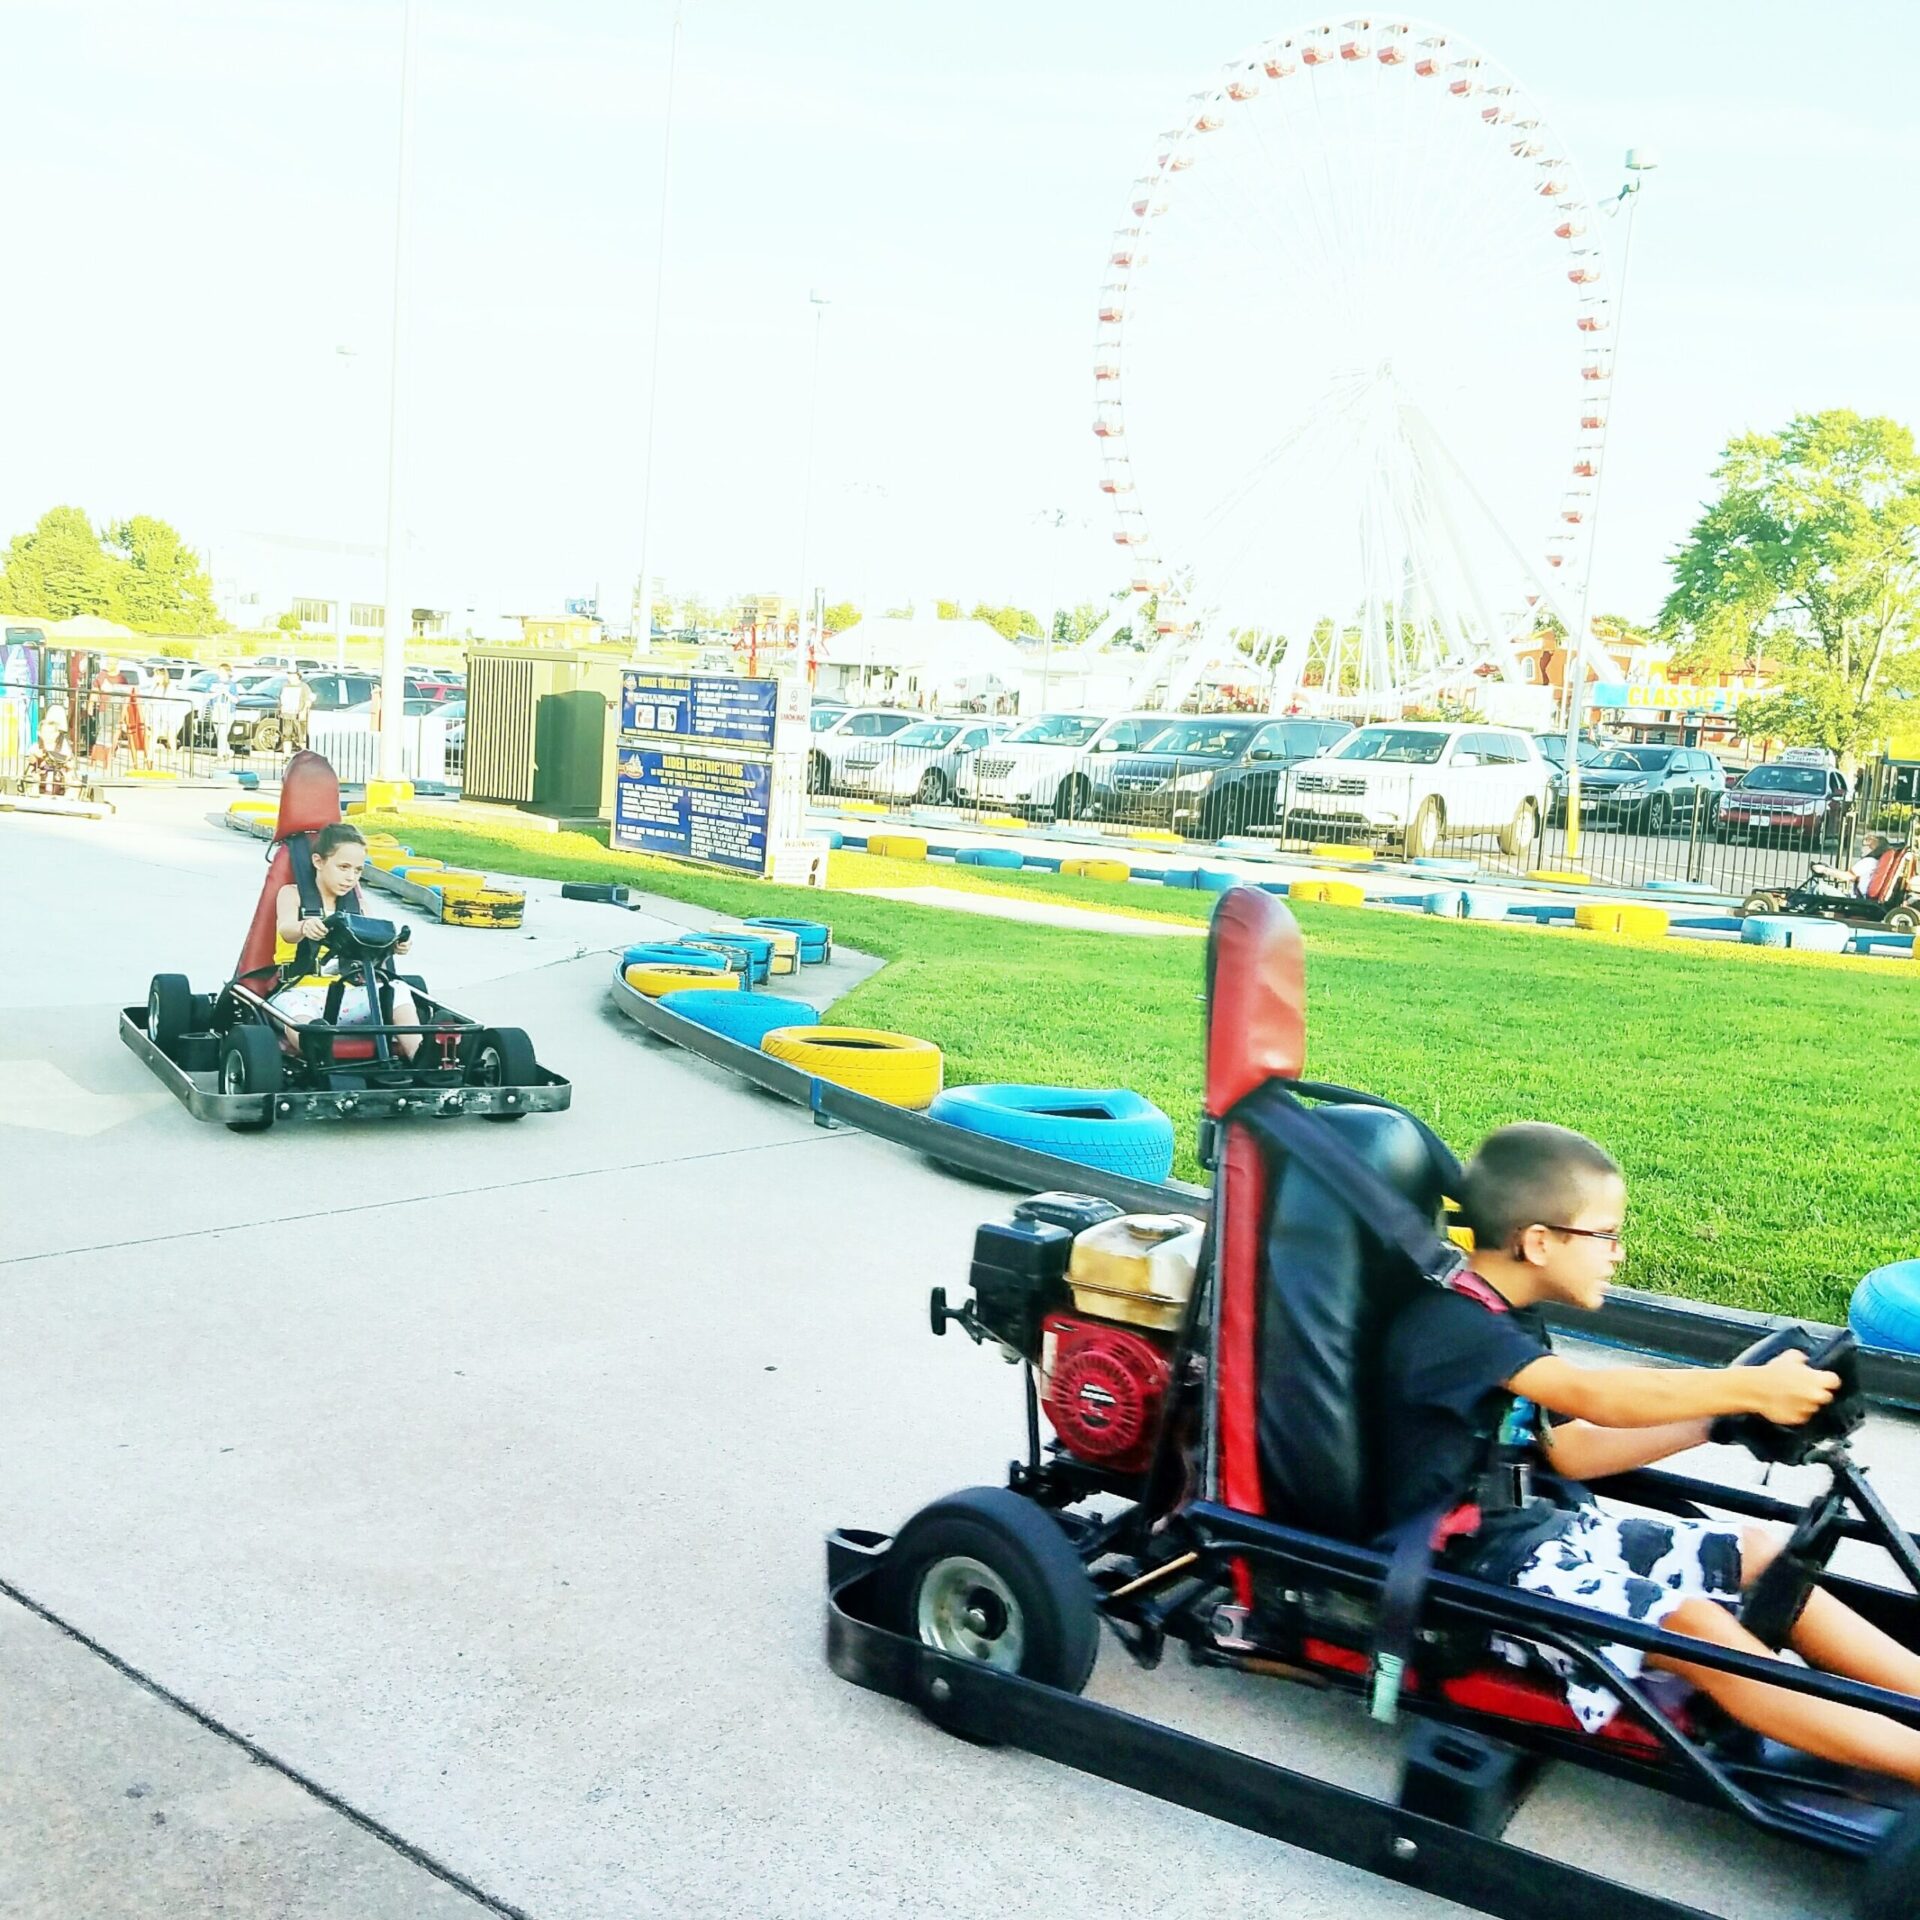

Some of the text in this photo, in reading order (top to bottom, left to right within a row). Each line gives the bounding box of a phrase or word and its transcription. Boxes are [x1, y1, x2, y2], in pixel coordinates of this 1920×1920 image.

[1628, 685, 1717, 709] CLASSIC
[662, 755, 686, 770] RIDER
[687, 758, 743, 777] RESTRICTIONS
